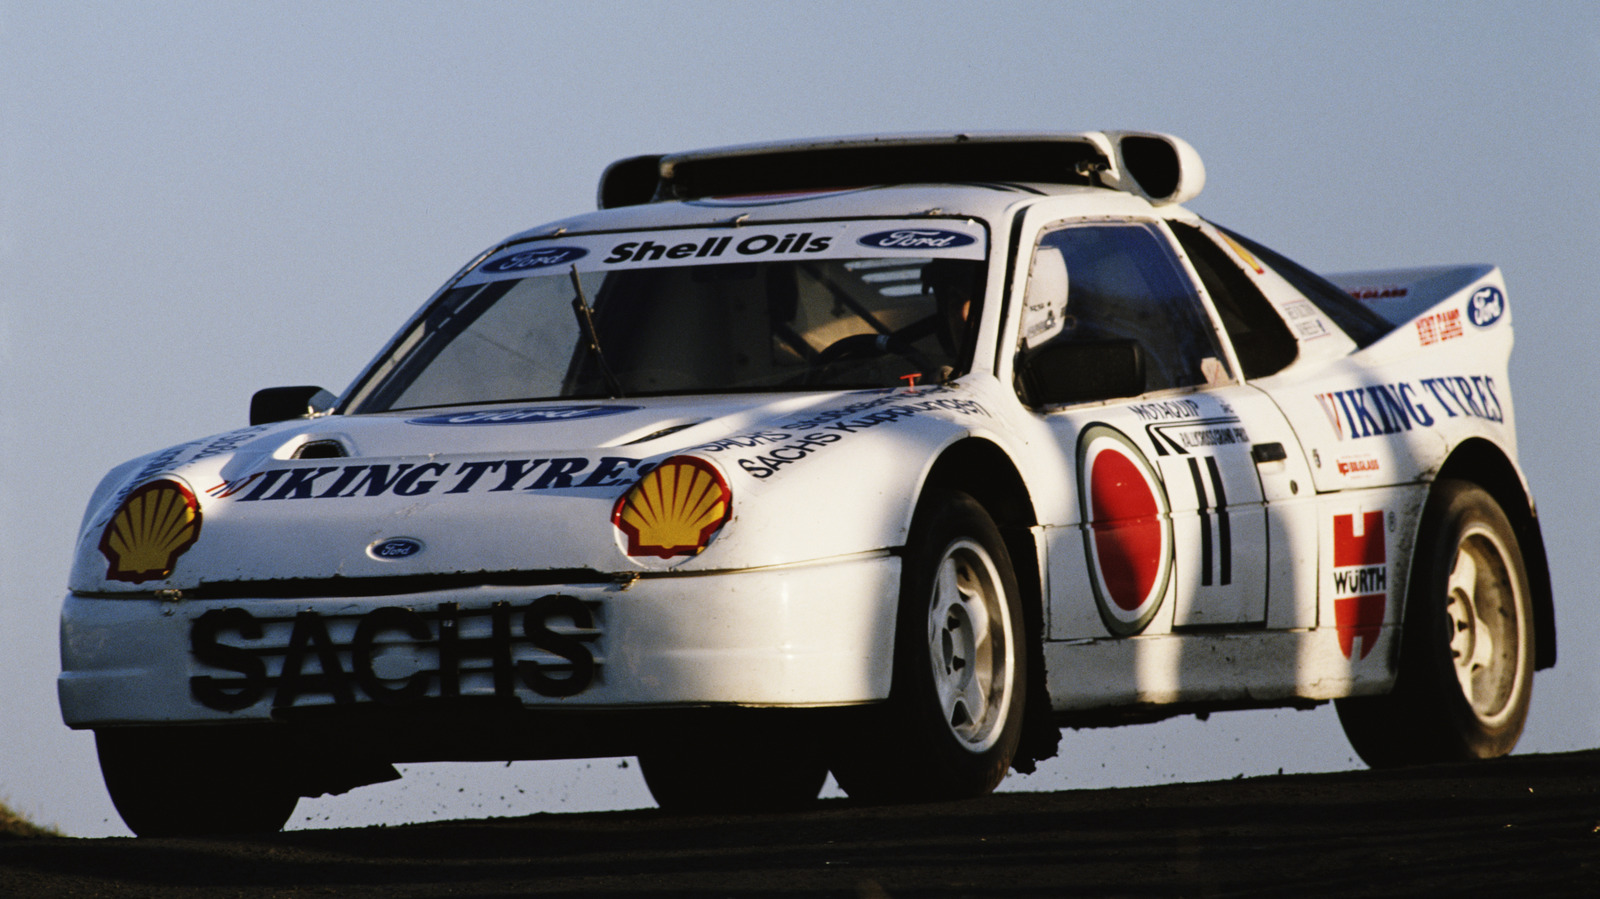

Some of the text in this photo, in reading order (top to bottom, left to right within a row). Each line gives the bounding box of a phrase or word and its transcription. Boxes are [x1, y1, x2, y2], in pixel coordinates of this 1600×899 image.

[602, 231, 834, 265] Shell Oils
[879, 229, 957, 250] Ford
[499, 247, 565, 271] Ford
[1472, 289, 1502, 325] Ford
[1128, 399, 1200, 420] MOTAQUIP
[1314, 375, 1504, 441] VIKING TYRES
[738, 398, 992, 479] SACHS Kupplungen
[205, 462, 443, 502] VIKING
[1187, 456, 1231, 586] 11
[380, 541, 410, 556] Ford
[1333, 566, 1387, 594] WÜRTH
[189, 594, 595, 711] SACHS
